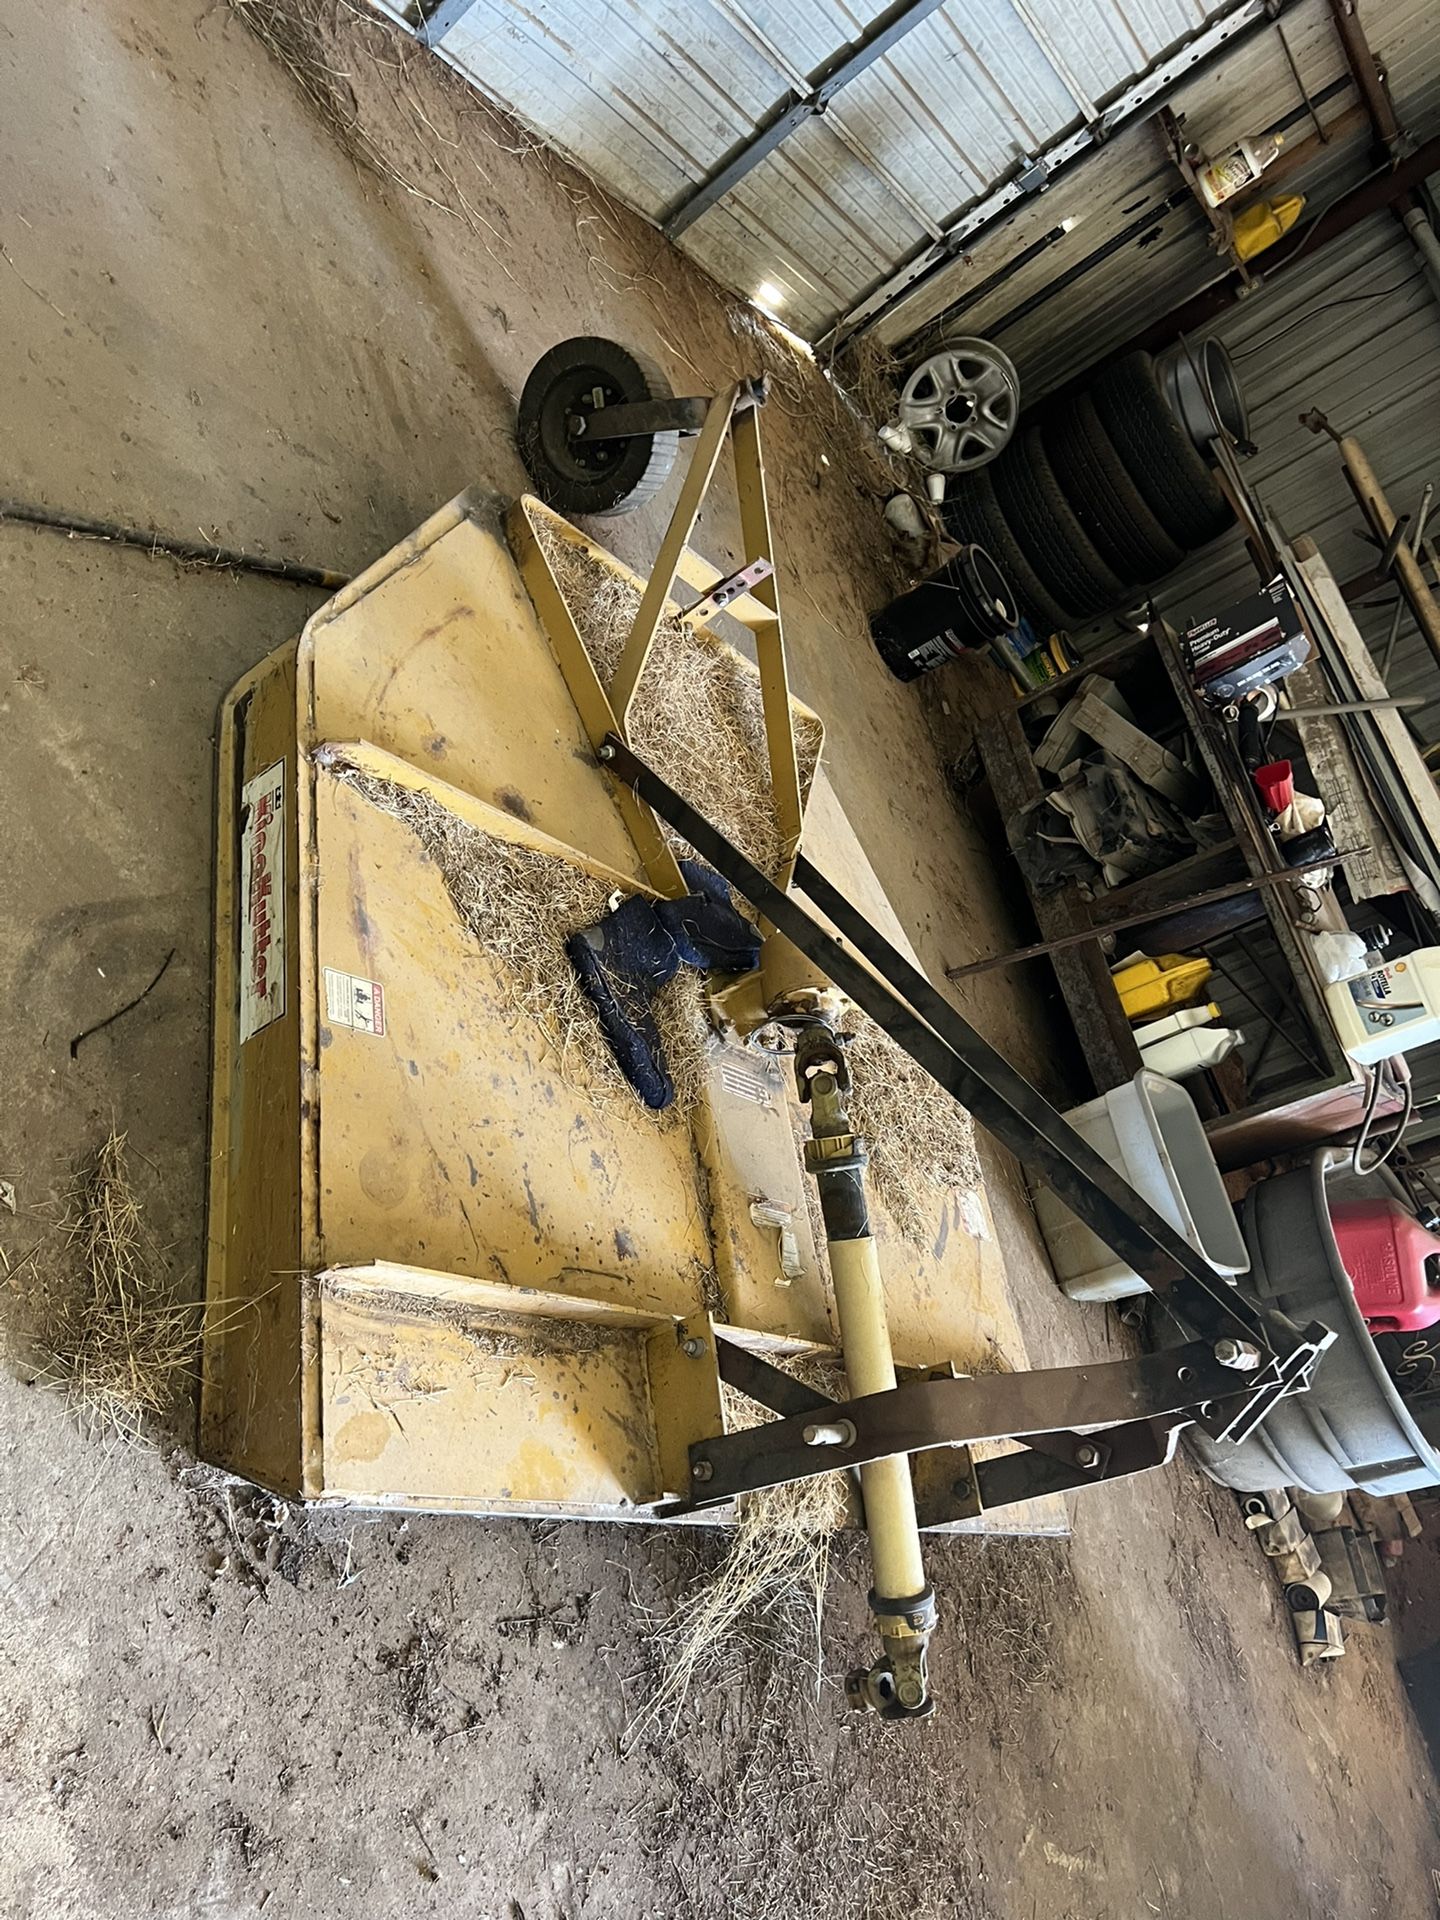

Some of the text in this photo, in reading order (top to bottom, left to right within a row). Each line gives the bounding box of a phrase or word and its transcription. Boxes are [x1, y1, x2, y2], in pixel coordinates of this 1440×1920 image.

[1189, 628, 1220, 647] Premium
[1377, 970, 1392, 995] ROTELLA
[374, 996, 383, 1032] DANGER
